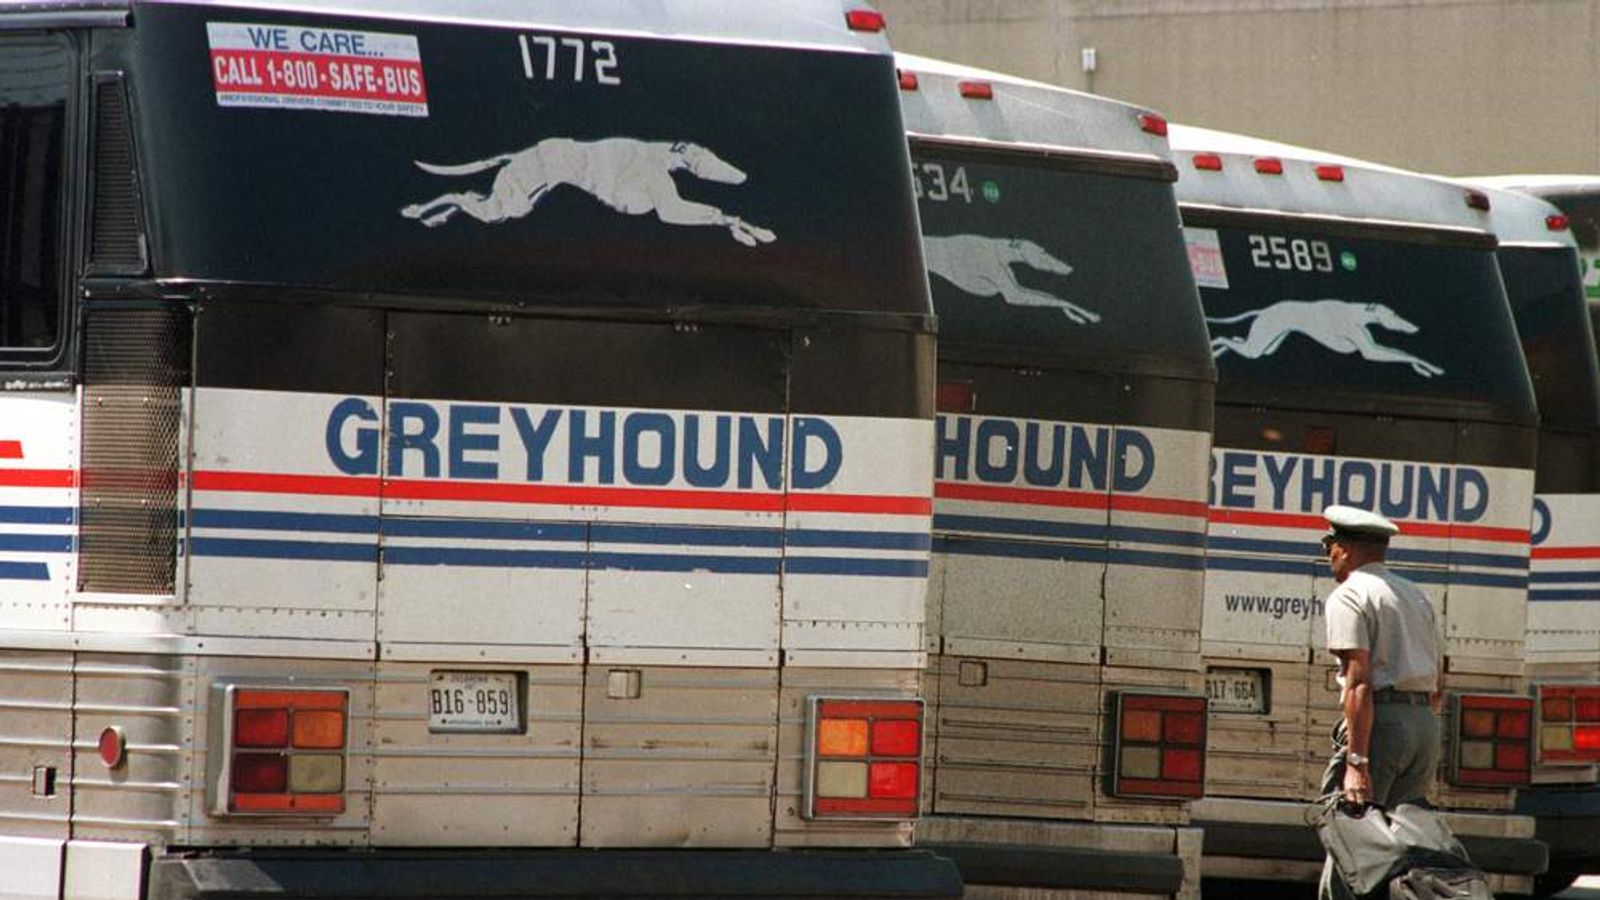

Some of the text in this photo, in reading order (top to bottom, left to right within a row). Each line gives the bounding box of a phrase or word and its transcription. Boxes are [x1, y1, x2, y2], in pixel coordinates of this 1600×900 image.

[247, 27, 384, 56] WE CARE...
[518, 34, 621, 85] 1772
[214, 56, 263, 85] CALL
[1249, 234, 1333, 272] 2589
[326, 397, 843, 491] GREYHOUND
[935, 415, 1155, 492] HOUND
[1208, 453, 1489, 522] EYHOUND
[431, 689, 509, 716] B16-859
